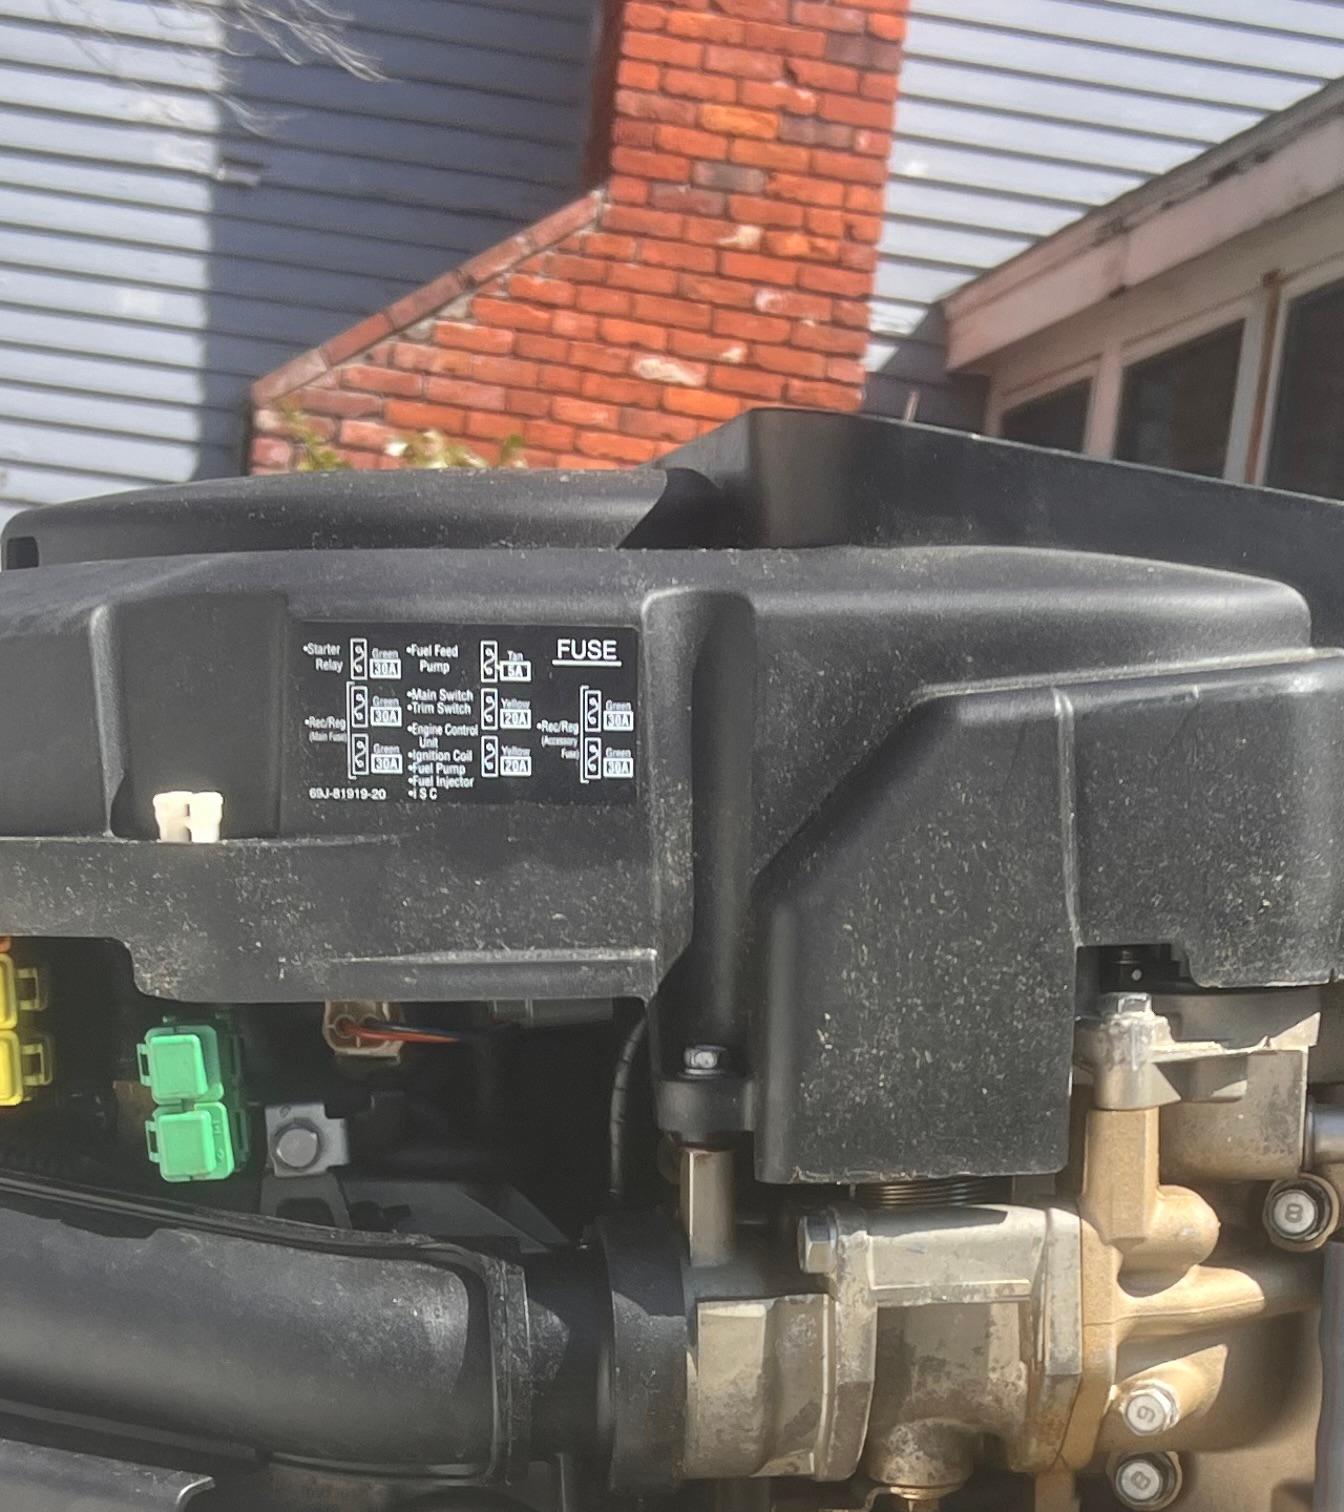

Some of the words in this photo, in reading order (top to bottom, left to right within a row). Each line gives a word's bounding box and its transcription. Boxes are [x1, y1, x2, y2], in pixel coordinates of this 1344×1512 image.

[307, 642, 341, 656] Starter
[372, 648, 399, 659] Green
[411, 643, 433, 657] Fuel
[434, 644, 459, 658] Feed
[557, 638, 617, 660] FUSE
[315, 658, 343, 673] Relay
[374, 662, 397, 676] 30A
[419, 659, 450, 675] Pump
[507, 665, 524, 677] 5A
[373, 695, 399, 707] Green
[411, 688, 437, 701] Main
[439, 688, 474, 702] Switch
[412, 702, 435, 715] Trim
[436, 702, 472, 715] Switch
[374, 710, 397, 722] 30A
[503, 712, 528, 726] 20A
[606, 713, 631, 727] 30A
[412, 722, 443, 737] Engine
[444, 723, 479, 736] Control
[373, 743, 400, 754] Green
[412, 749, 451, 763] Ignition
[452, 749, 473, 762] Coil
[375, 758, 398, 771] 30A
[412, 762, 434, 775] Fuel
[435, 762, 466, 776] Pump
[503, 760, 528, 773] 20A
[606, 761, 631, 774] 30A
[412, 775, 434, 787] Fuel
[435, 776, 475, 790] Injector
[308, 787, 387, 800] 69J-81919-20
